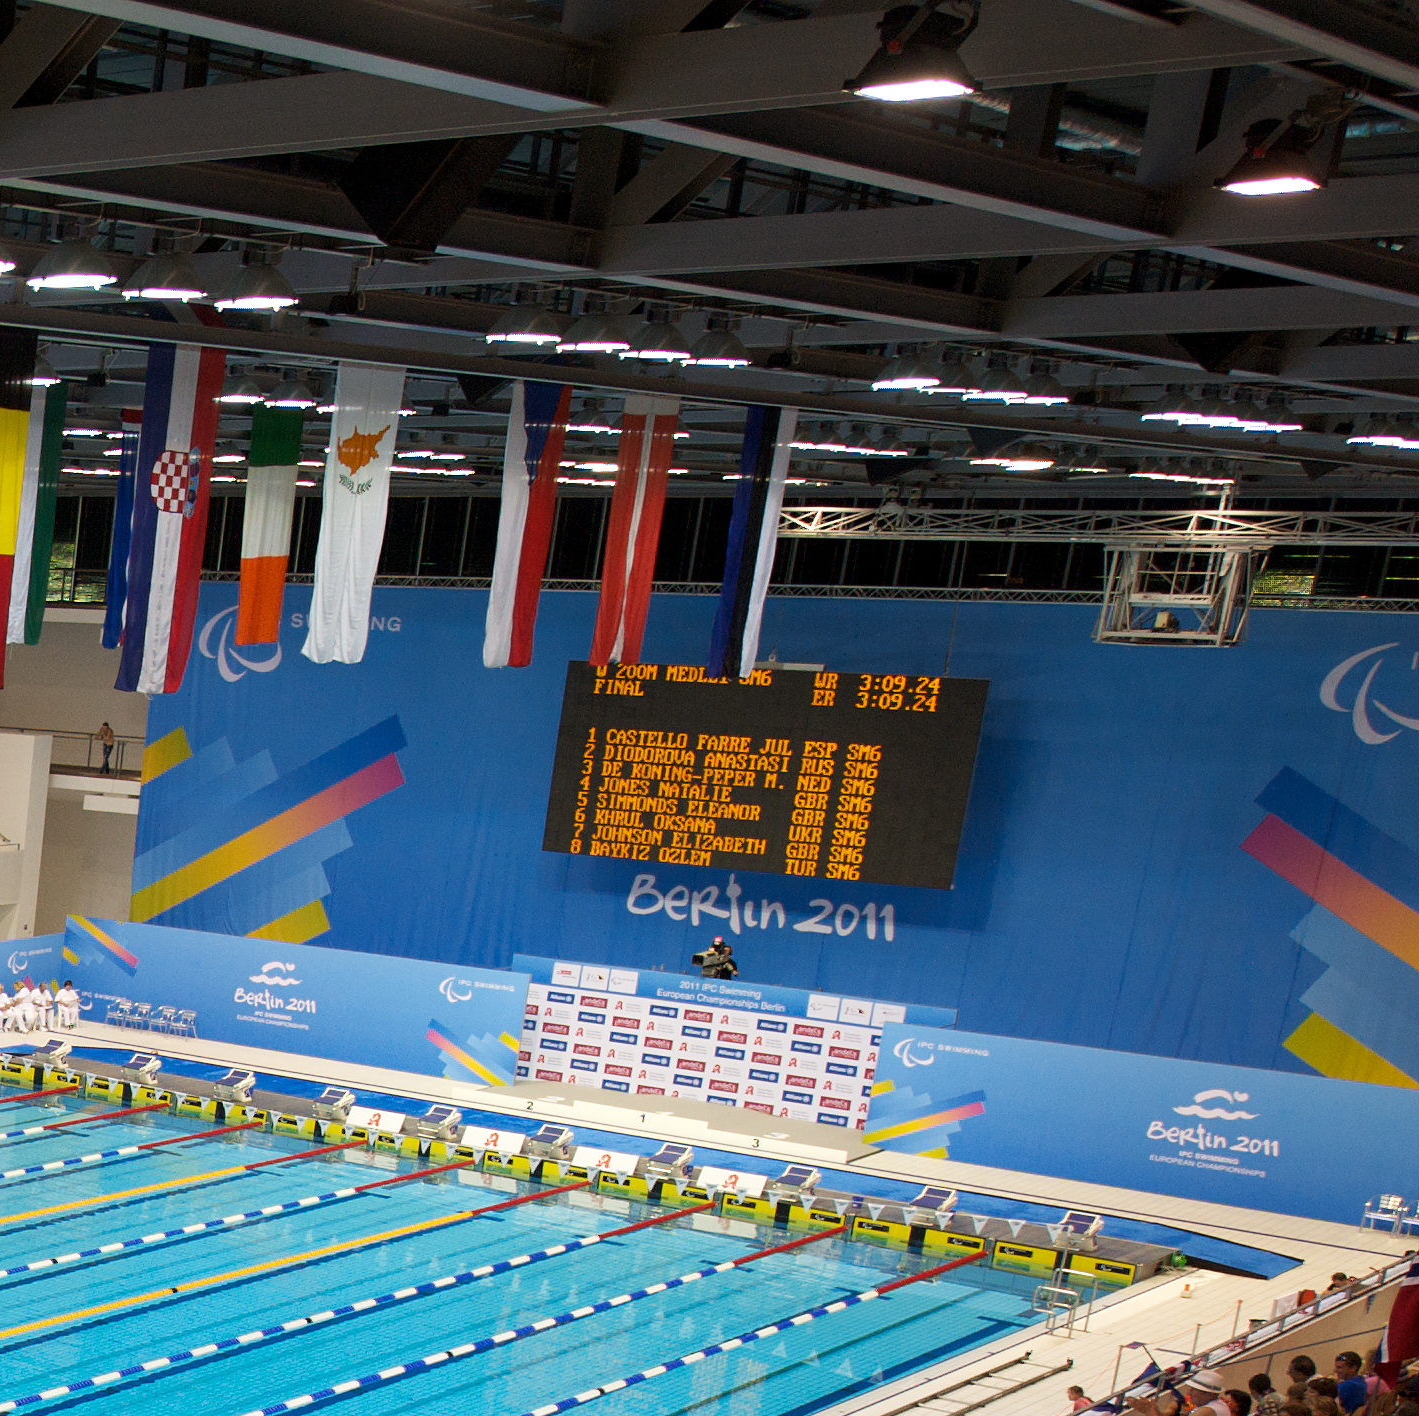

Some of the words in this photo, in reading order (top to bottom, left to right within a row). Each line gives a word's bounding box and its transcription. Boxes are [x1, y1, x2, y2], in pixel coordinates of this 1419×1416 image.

[593, 679, 645, 697] FINAL
[615, 663, 658, 681] 200M
[666, 665, 730, 685] MEDL
[814, 672, 839, 690] WR
[859, 674, 941, 695] 3:09.24
[811, 689, 836, 707] ER
[855, 691, 938, 712] 3:09.24
[588, 727, 597, 743] 1
[606, 728, 689, 749] CASTELLO
[696, 734, 752, 753] FARRE
[759, 738, 792, 756] JUL
[802, 740, 838, 759] ESP
[846, 743, 882, 761] SM6
[581, 760, 593, 775] 3
[600, 761, 622, 777] DE
[630, 764, 757, 787] KONING-PEPER
[764, 773, 784, 790] M.
[796, 775, 832, 793] NED
[840, 778, 876, 796] SM6
[583, 743, 595, 759] 2
[603, 745, 696, 766] DIODOROVA
[704, 752, 790, 772] ANASTASI
[799, 758, 835, 776] RUS
[843, 761, 879, 780] SM6
[577, 792, 588, 807] 5
[597, 793, 679, 814] SIMMONDS
[686, 801, 762, 821] ELEANOR
[791, 809, 826, 827] GBR
[834, 812, 870, 831] SM6
[579, 776, 590, 791] 4
[598, 778, 651, 796] JONES
[657, 781, 733, 803] NATALIE
[794, 792, 829, 810] GBR
[837, 795, 873, 813] SM6
[573, 824, 584, 838] 7
[591, 824, 663, 846] JOHNSON
[671, 832, 767, 855] ELIZABETH
[785, 842, 820, 861] GBR
[828, 846, 864, 864] SM6
[574, 807, 586, 823] 6
[594, 808, 645, 828] KHRUL
[653, 814, 717, 834] OKSANA
[788, 825, 823, 843] UKR
[831, 829, 867, 847] SM6
[570, 839, 582, 854] 8
[590, 840, 651, 861] BAYKIZ
[658, 848, 712, 867] OZLEM
[785, 859, 818, 877] TUR
[826, 862, 861, 881] SM6
[792, 898, 895, 942] 2011
[285, 998, 317, 1014] 2011
[526, 1101, 534, 1110] 2
[751, 1138, 760, 1148] 3
[1229, 1135, 1281, 1157] 2011
